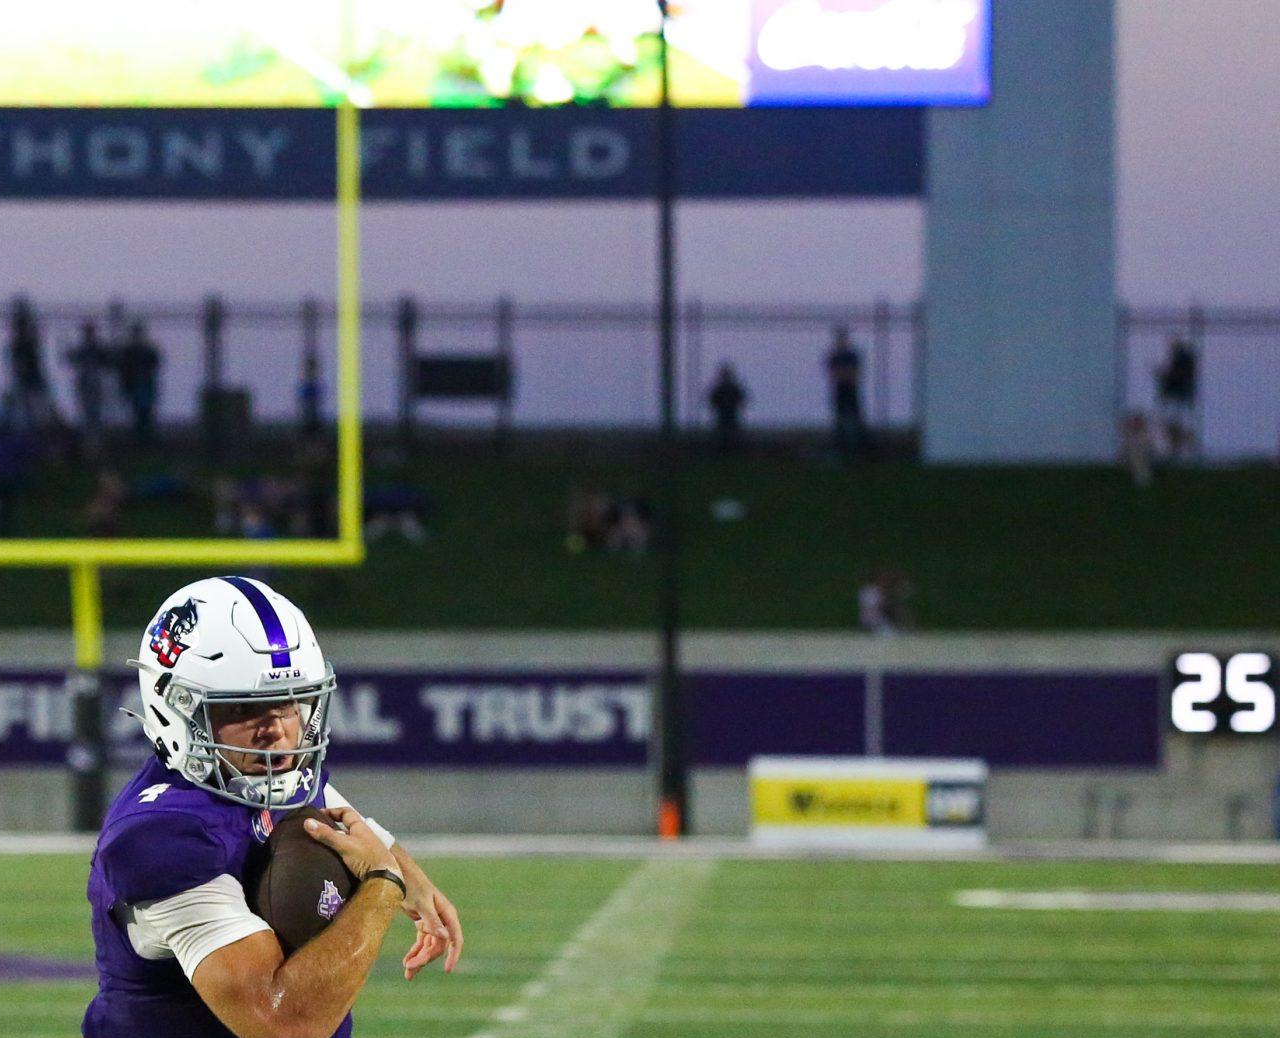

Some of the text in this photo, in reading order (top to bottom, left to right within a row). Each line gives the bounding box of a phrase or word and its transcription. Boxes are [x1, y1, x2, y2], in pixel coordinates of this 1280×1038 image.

[268, 669, 301, 680] WTB
[1170, 652, 1276, 733] 25
[420, 683, 652, 744] TRUST
